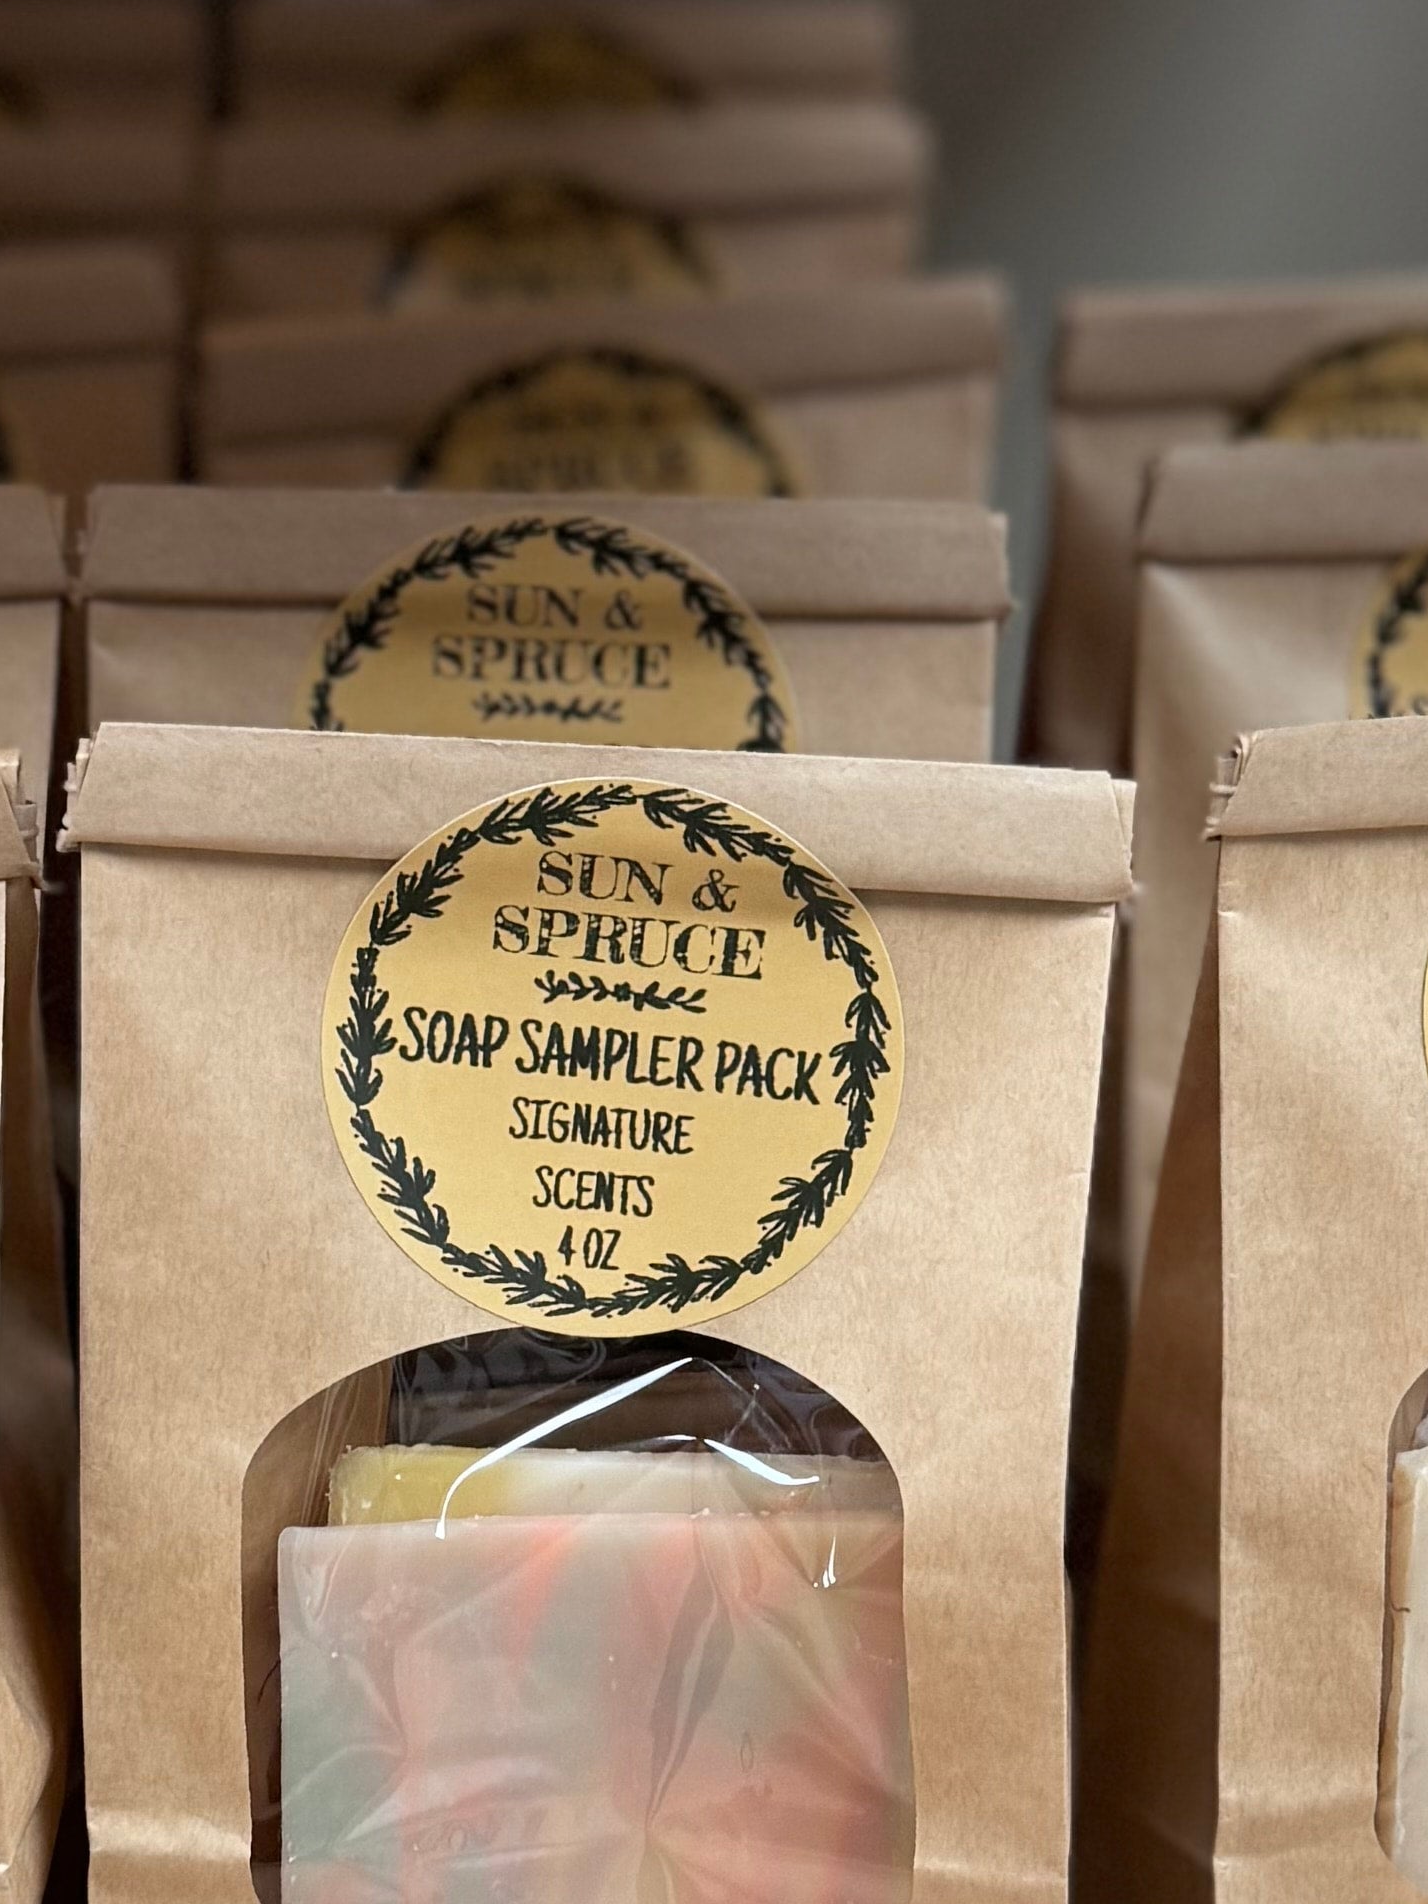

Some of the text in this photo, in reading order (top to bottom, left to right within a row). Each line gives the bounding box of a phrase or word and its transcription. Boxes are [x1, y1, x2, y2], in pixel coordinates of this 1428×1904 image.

[466, 584, 643, 631] SUN &
[433, 634, 671, 688] SPRUCE
[537, 851, 740, 913] SUN &
[493, 905, 766, 980] SPRUCE
[398, 1006, 822, 1105] SOAP SAMPLER PACK
[509, 1096, 695, 1155] SIGNATURE
[532, 1165, 655, 1217] SCENTS
[557, 1225, 621, 1270] 4 OZ
